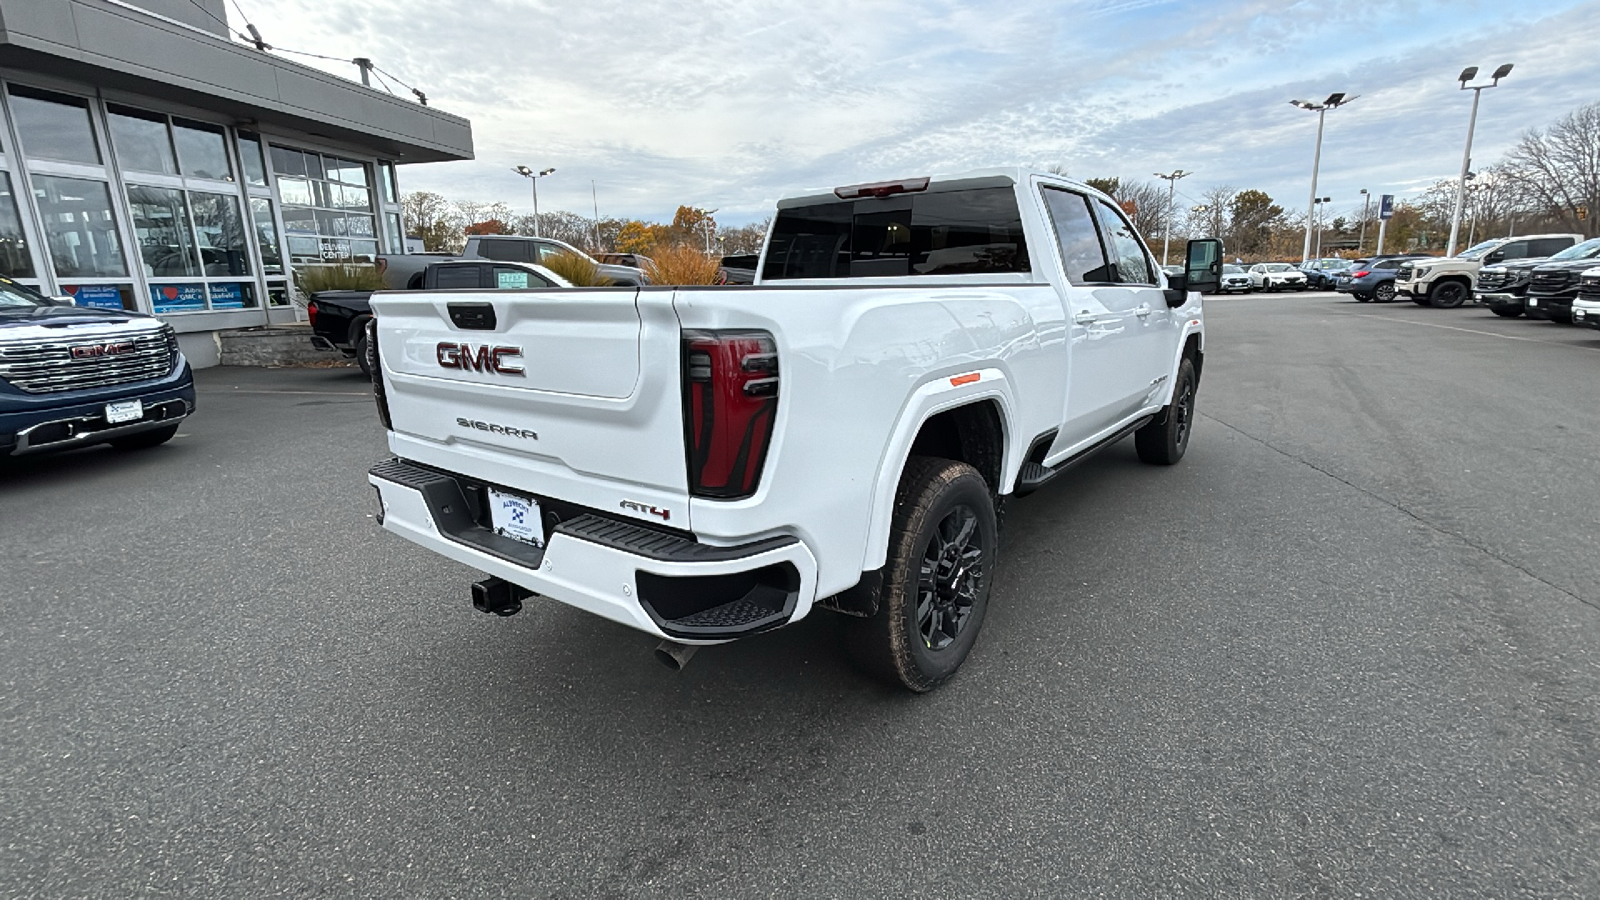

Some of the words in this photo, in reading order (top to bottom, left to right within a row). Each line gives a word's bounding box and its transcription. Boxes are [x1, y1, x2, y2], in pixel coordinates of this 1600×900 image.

[319, 243, 350, 251] DELIVERY
[322, 251, 350, 259] CENTER
[71, 341, 133, 359] GMC
[436, 341, 526, 378] GMC
[456, 417, 539, 440] SIERRA
[619, 499, 671, 521] AT4
